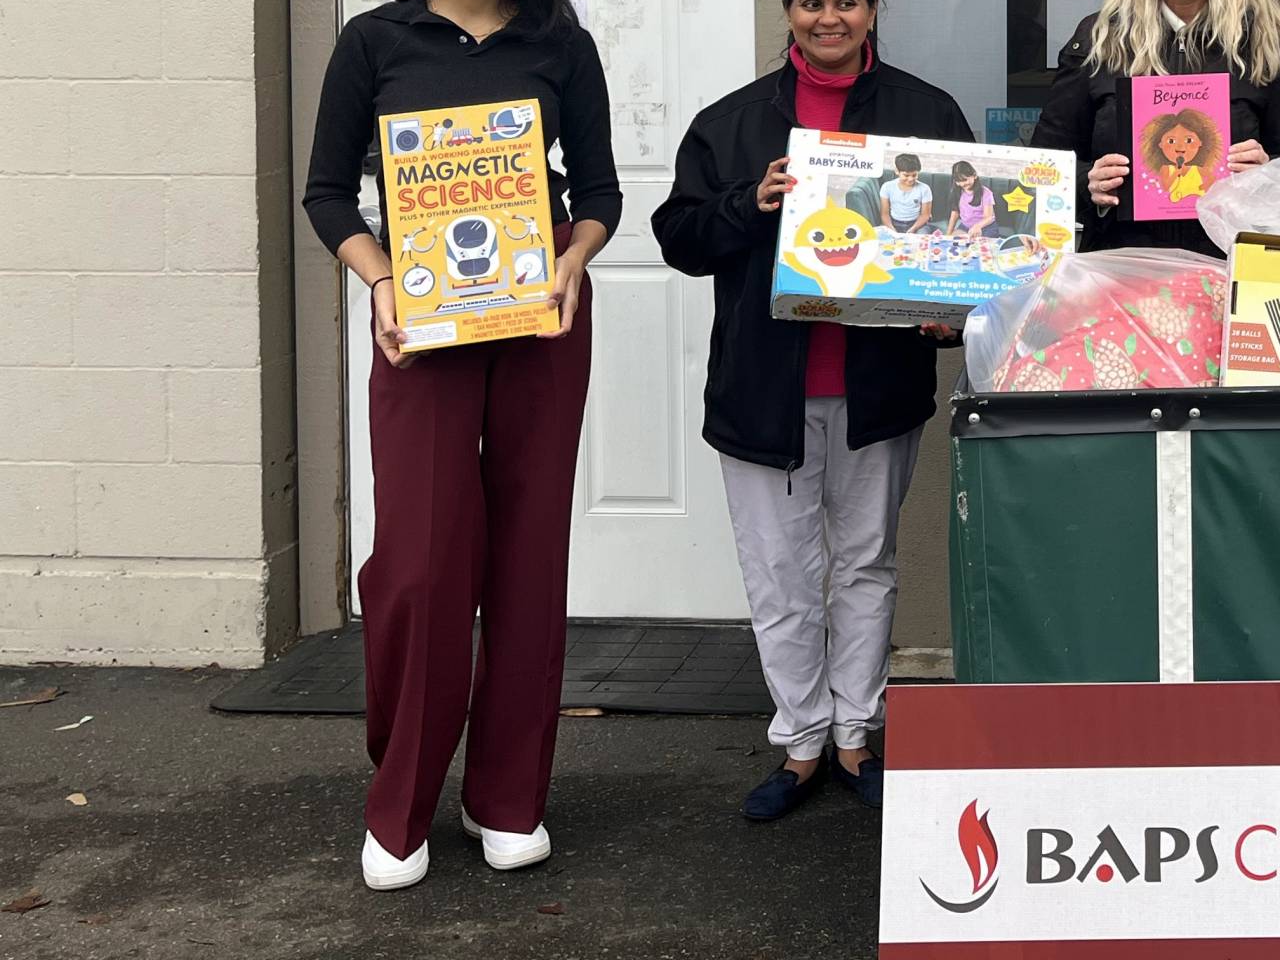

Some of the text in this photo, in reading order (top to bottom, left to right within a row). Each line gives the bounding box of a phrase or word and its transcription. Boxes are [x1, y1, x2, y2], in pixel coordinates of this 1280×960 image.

[1153, 86, 1209, 107] Beyoncé
[989, 110, 1040, 122] FINALI
[394, 157, 418, 165] BUILD
[429, 151, 470, 161] WORKING
[508, 142, 532, 151] TRAIN
[809, 157, 874, 170] BABY SHARK
[397, 152, 527, 186] MAGNETIC
[398, 173, 537, 213] SCIENCE
[399, 214, 418, 222] PLUS
[427, 210, 450, 218] OTHER
[451, 204, 489, 215] MAGNETIC
[490, 199, 538, 210] EXPERIMENTS
[908, 279, 938, 288] Dough
[940, 281, 967, 290] Magic
[968, 282, 992, 291] Shop
[924, 289, 954, 298] Family
[1241, 342, 1263, 350] STICKS
[1026, 824, 1219, 884] BAPS
